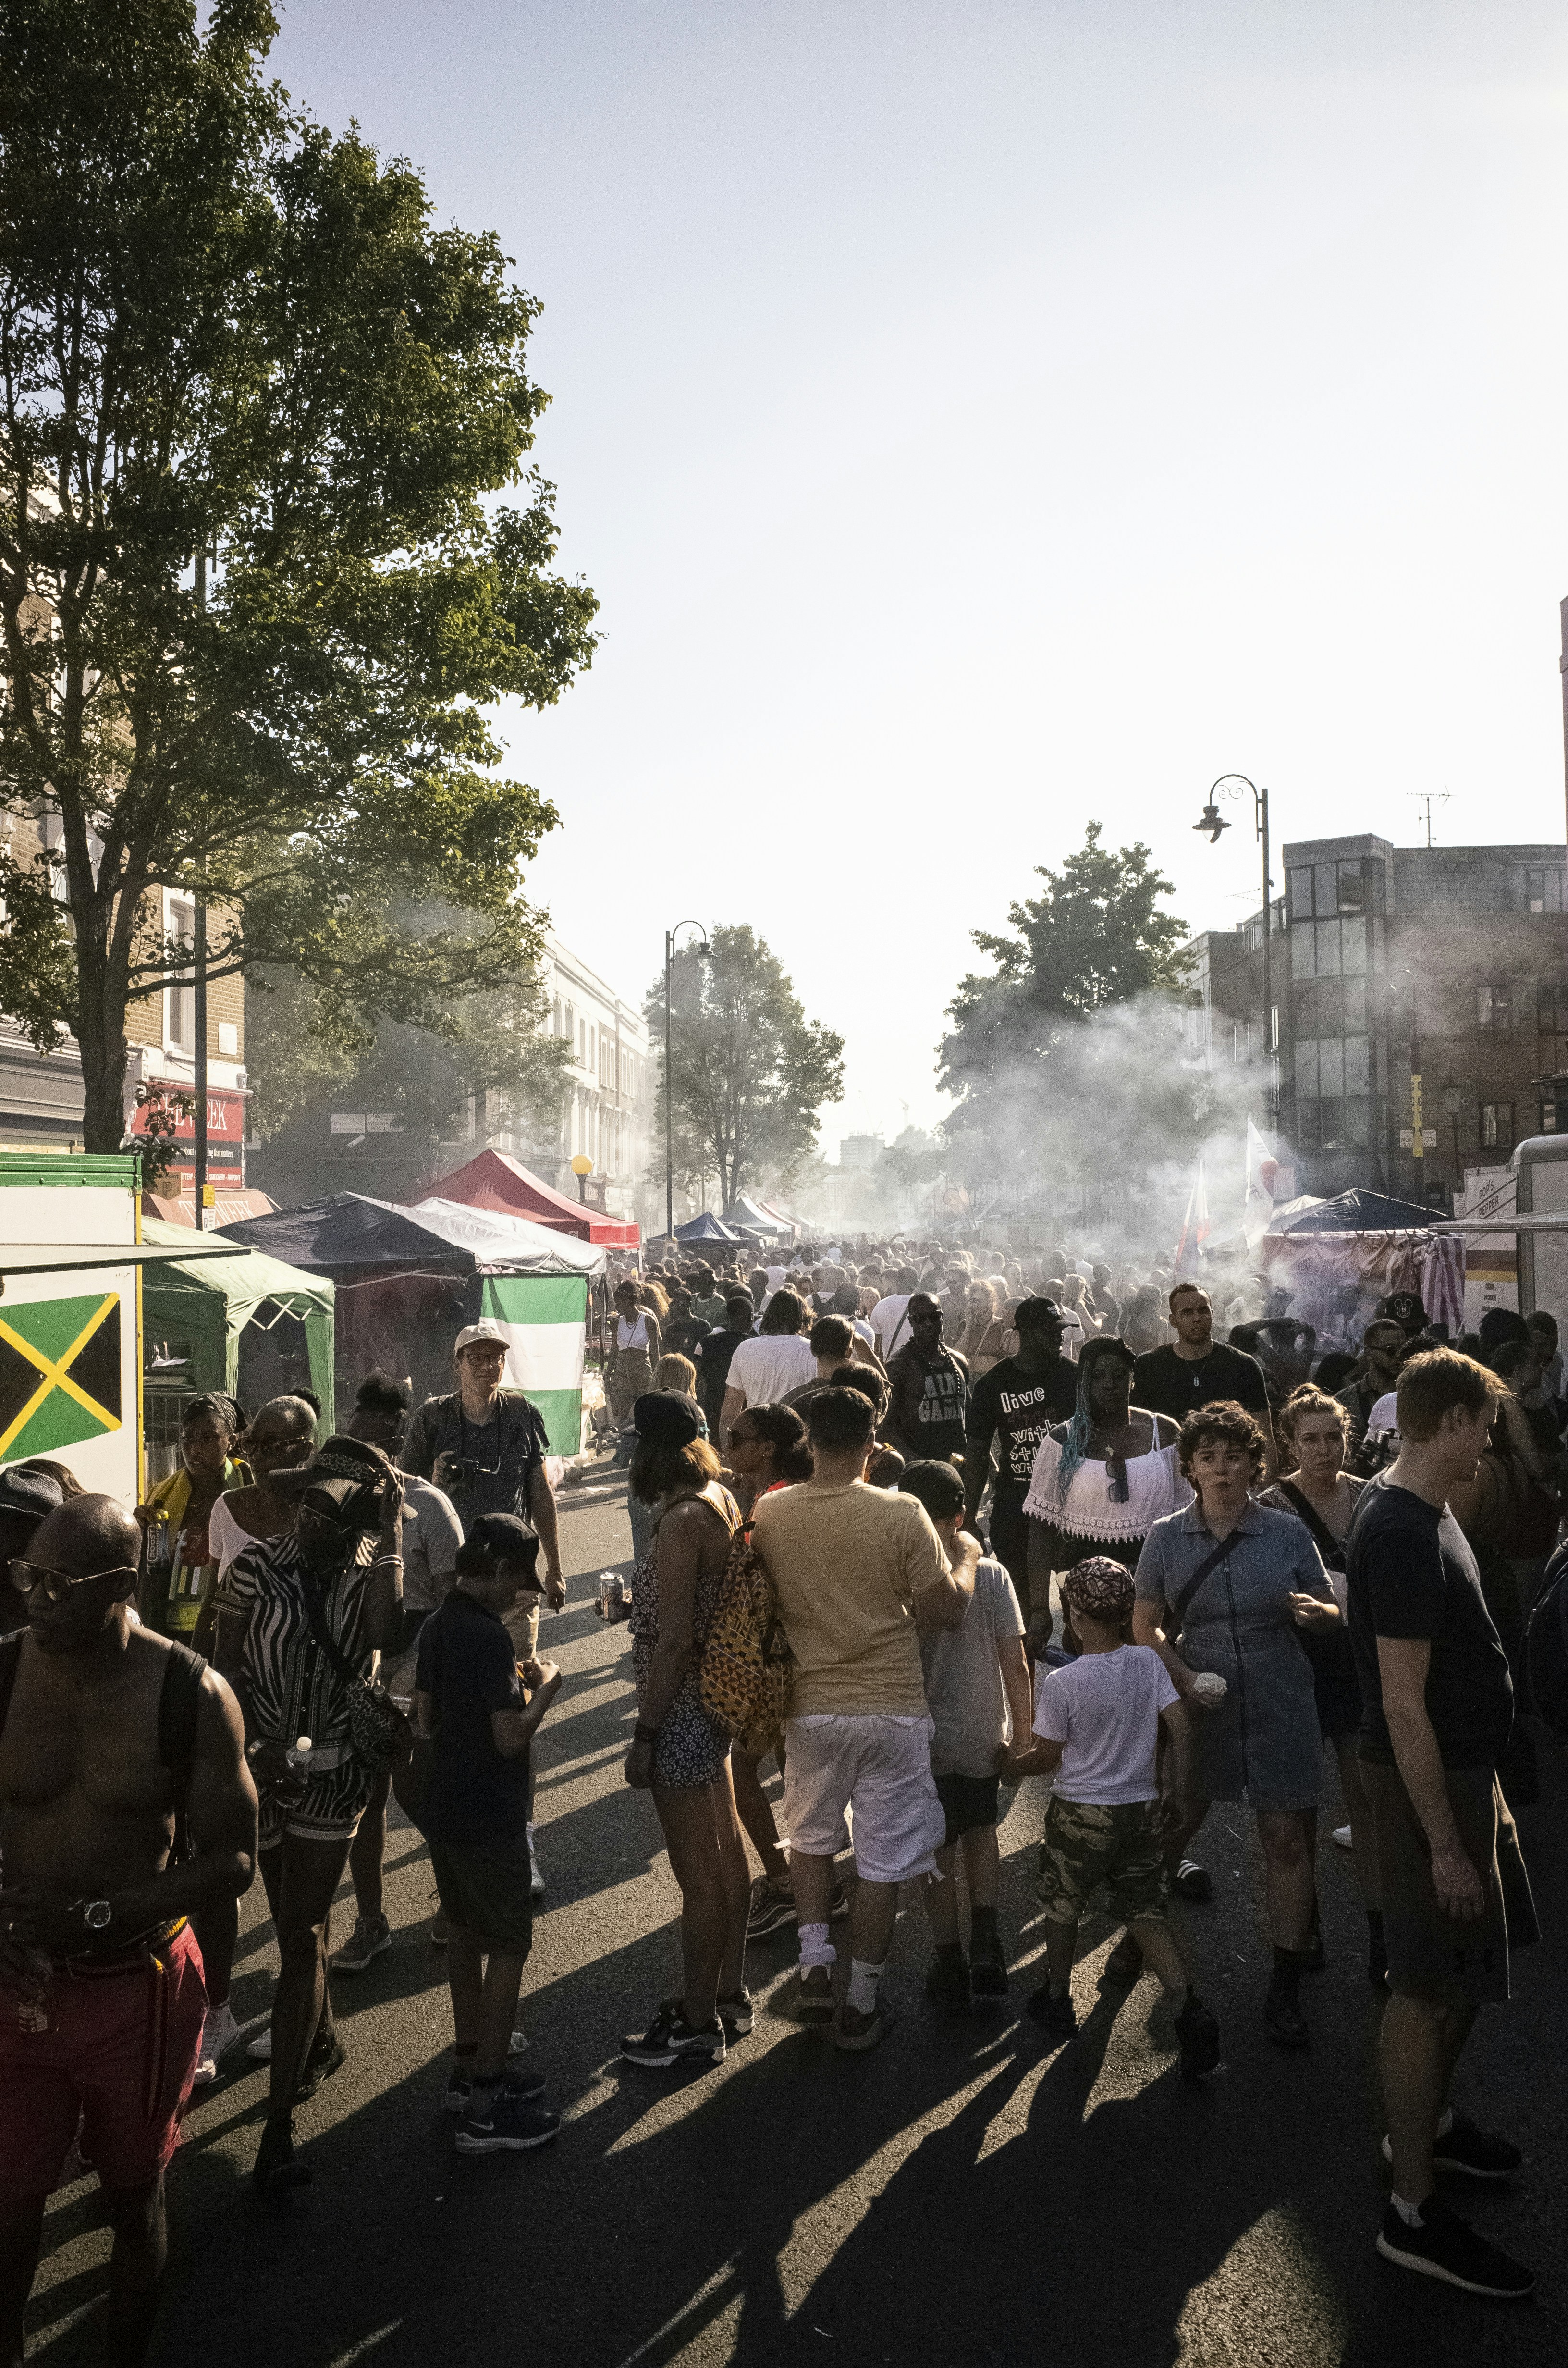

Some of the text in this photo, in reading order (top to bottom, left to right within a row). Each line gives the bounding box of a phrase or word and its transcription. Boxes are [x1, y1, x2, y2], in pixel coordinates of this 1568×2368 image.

[1479, 1195, 1499, 1218] PEPPER
[1000, 1387, 1045, 1413] live
[1010, 1419, 1057, 1444] with
[1010, 1460, 1036, 1473] wi
